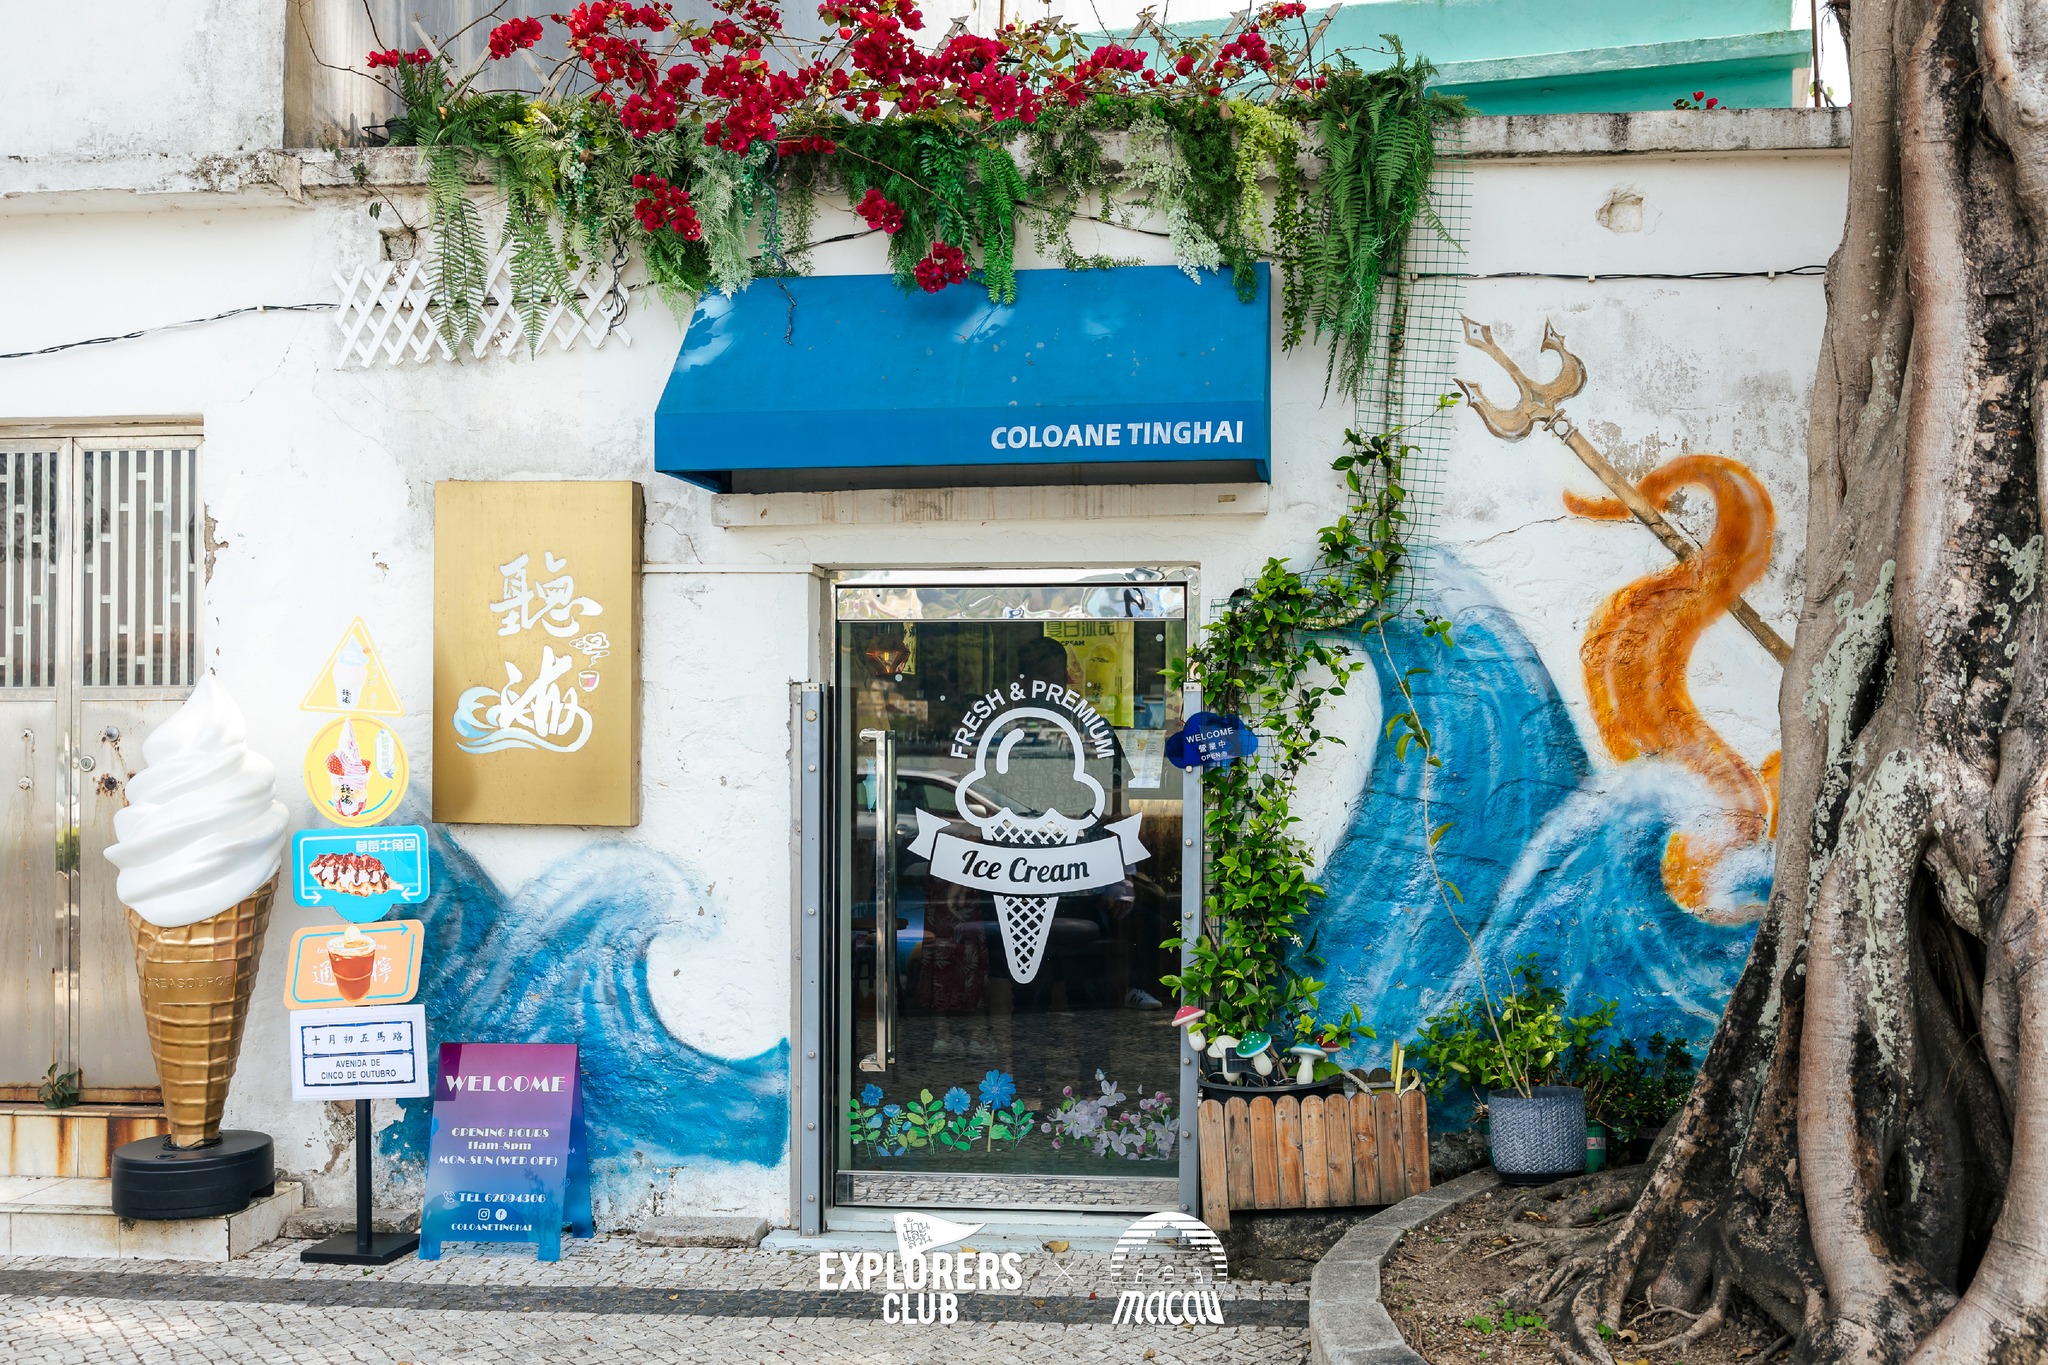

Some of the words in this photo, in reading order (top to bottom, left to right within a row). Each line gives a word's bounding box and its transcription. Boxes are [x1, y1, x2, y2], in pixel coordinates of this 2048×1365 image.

[990, 423, 1121, 449] COLOANE
[1127, 420, 1244, 445] TINGHAI
[950, 689, 1006, 759] FRESH
[1010, 682, 1026, 701] &
[1032, 680, 1115, 759] PREMIUM
[1186, 727, 1234, 744] WELCOME
[1198, 740, 1227, 754] 營業中
[1201, 752, 1221, 762] OPEN
[355, 838, 417, 853] 草莓牛角包
[962, 850, 1002, 880] Ice
[1009, 857, 1090, 883] Cream
[311, 1030, 403, 1046] 十月初五馬路
[335, 1059, 367, 1068] AVENIDA
[370, 1058, 381, 1067] DE
[321, 1071, 344, 1080] CINCO
[346, 1071, 357, 1079] DE
[360, 1069, 397, 1078] OUTUBRO
[445, 1075, 566, 1093] WELCOME
[451, 1127, 506, 1138] OPENING
[508, 1128, 550, 1138] HOURS
[467, 1140, 532, 1151] 11am-8pm
[437, 1155, 494, 1166] MON-SUN
[495, 1155, 527, 1167] (WED
[530, 1156, 558, 1167] OFF)
[459, 1192, 482, 1203] TEL
[484, 1193, 546, 1204] 62094306
[451, 1223, 533, 1232] COLOANETINGHAI
